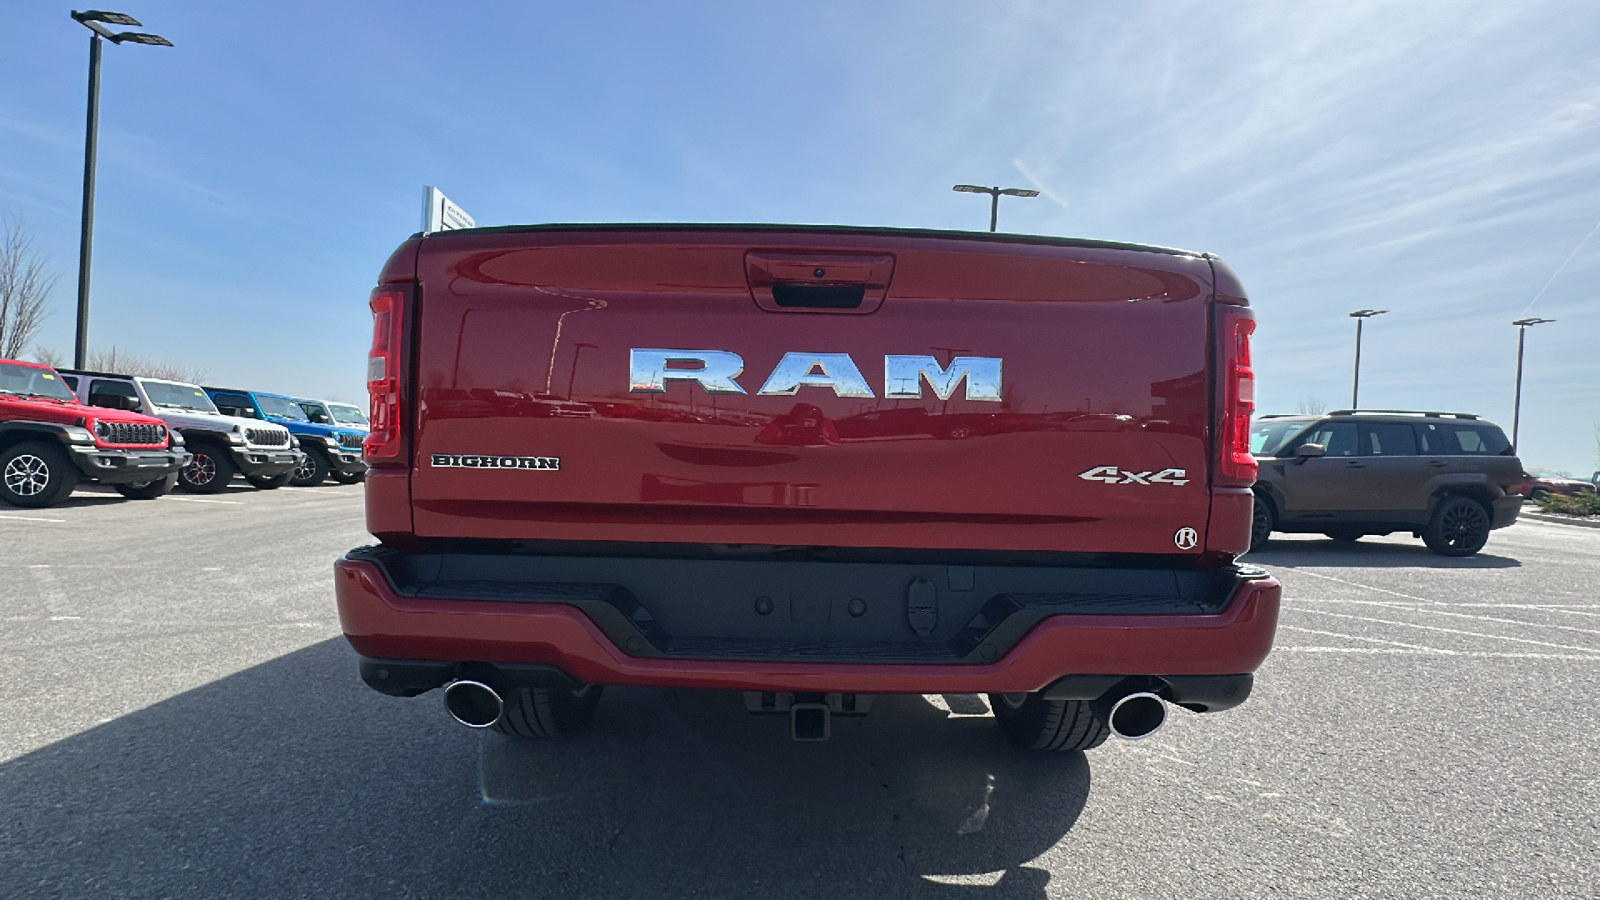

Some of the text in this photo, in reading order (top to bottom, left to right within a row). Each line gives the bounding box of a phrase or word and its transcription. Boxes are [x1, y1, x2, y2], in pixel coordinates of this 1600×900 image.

[629, 348, 1003, 402] RAM
[430, 453, 560, 470] BIGHORN
[1078, 465, 1190, 486] 4x4
